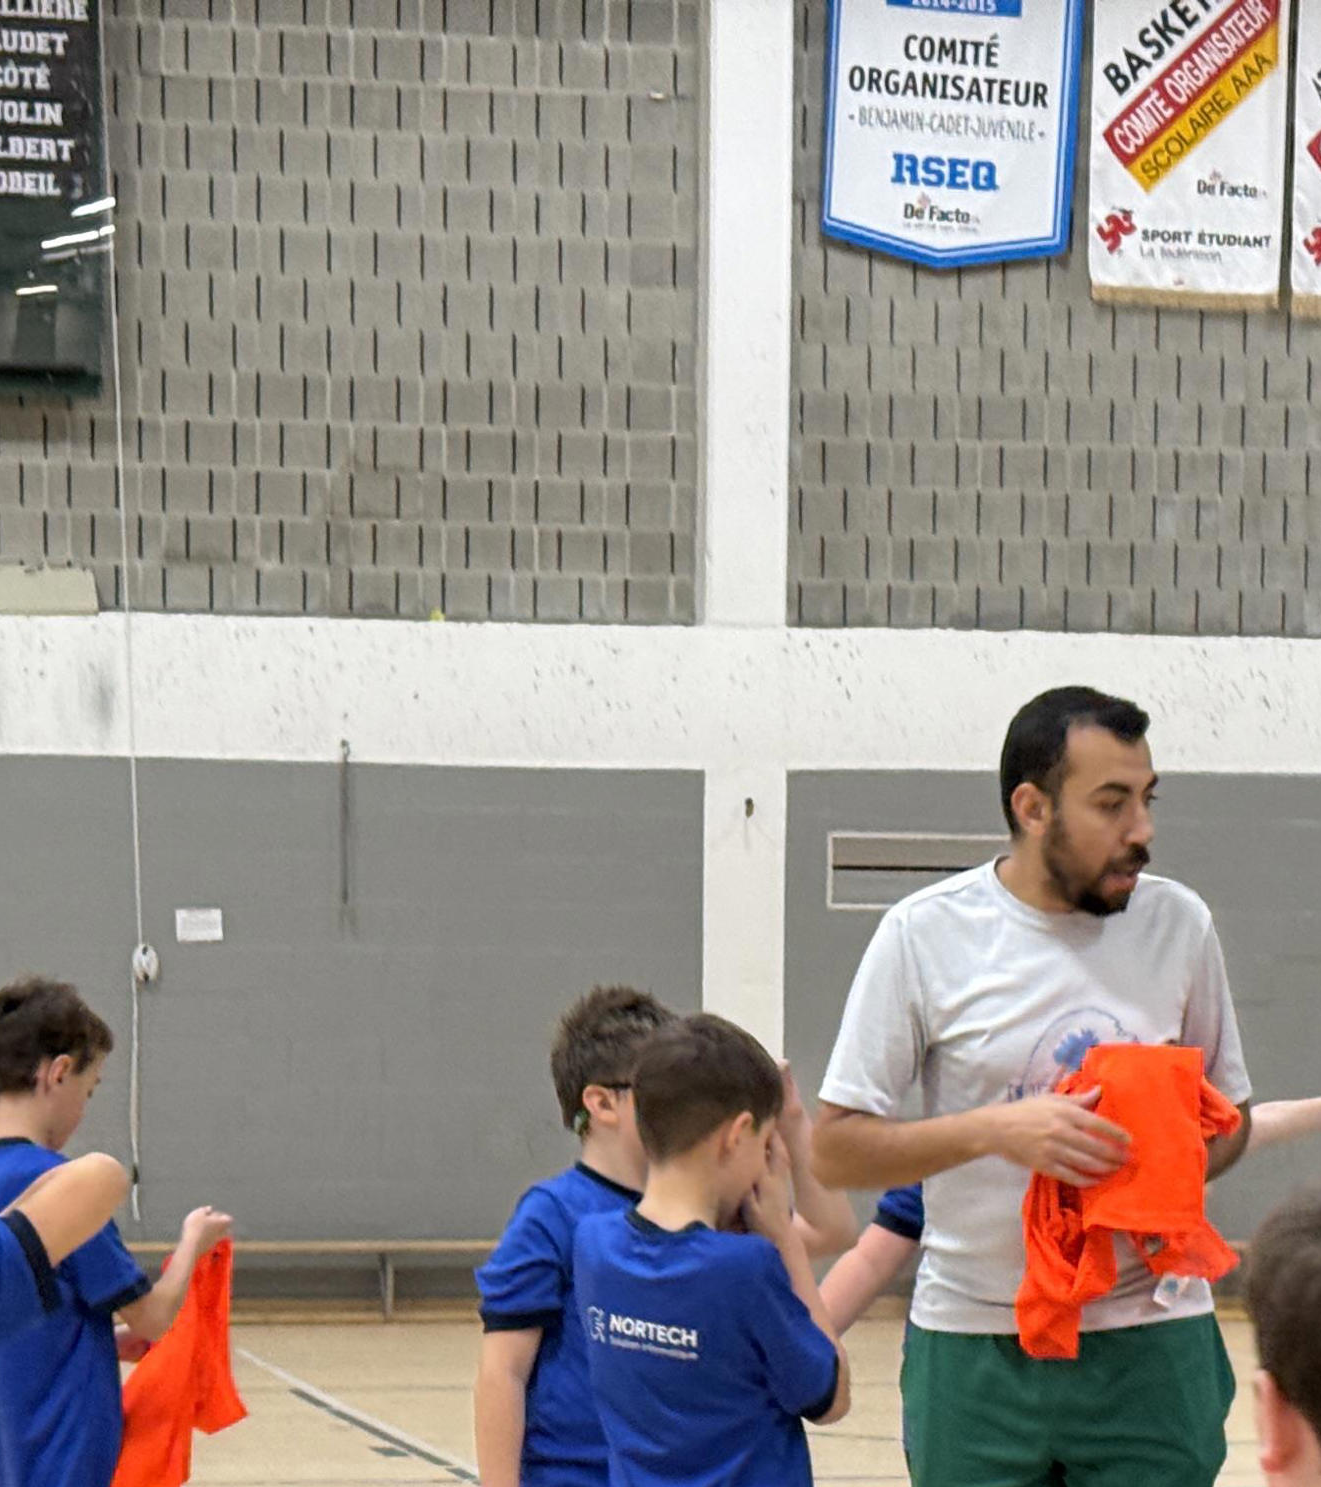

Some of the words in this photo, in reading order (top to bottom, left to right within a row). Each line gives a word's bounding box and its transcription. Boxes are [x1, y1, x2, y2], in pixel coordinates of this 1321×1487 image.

[904, 33, 1000, 68] COMITÉ
[1163, 0, 1271, 105] ORGANISATEUR
[848, 65, 1049, 108] ORGANISATEUR
[1140, 91, 1232, 180] SCOLAIRE
[1230, 52, 1273, 97] AAA
[891, 152, 999, 191] RSEQ
[1141, 229, 1192, 244] SPORT
[1197, 229, 1272, 248] ÉTUDIANT
[609, 1313, 698, 1348] NORTECH
